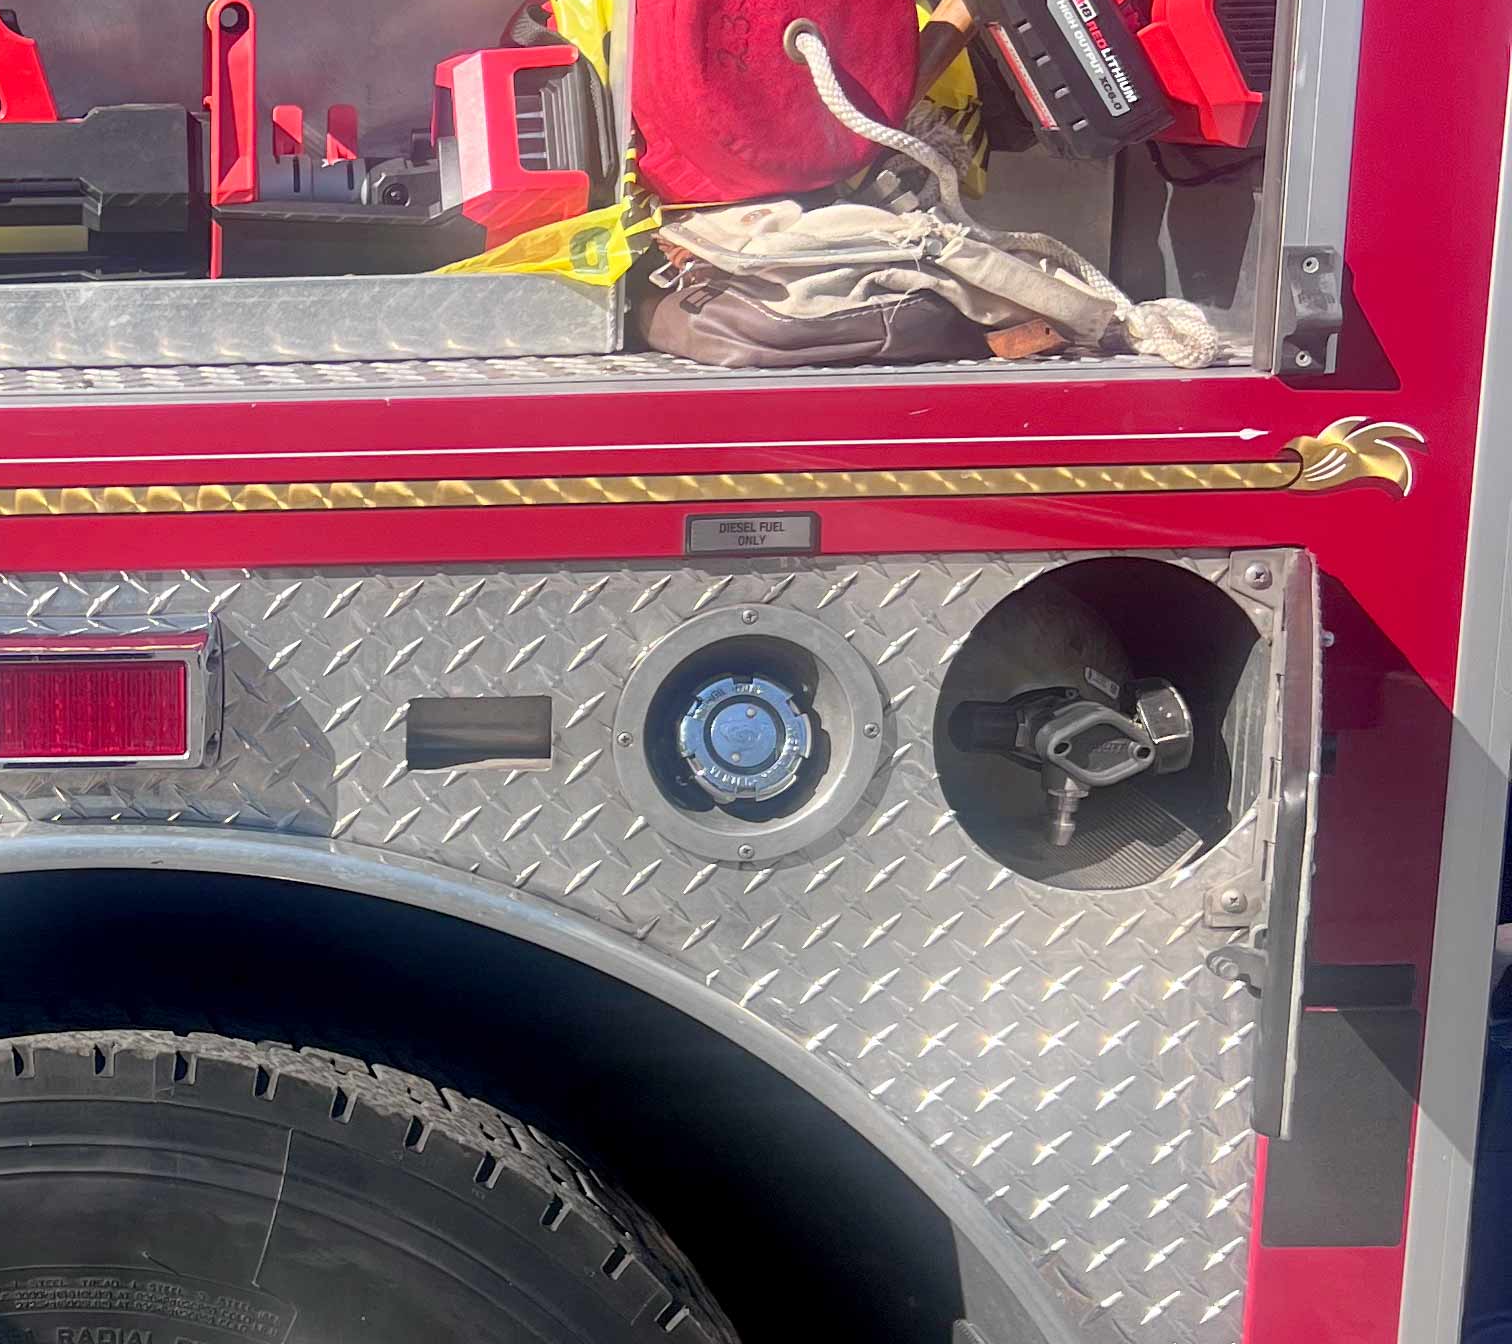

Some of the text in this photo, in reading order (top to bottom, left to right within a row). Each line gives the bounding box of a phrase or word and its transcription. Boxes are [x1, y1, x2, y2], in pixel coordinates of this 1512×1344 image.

[1073, 29, 1105, 76] OUTPUT
[1099, 75, 1123, 112] XC6.0
[719, 521, 785, 534] DIESEL FUEL
[738, 535, 767, 546] ONLY
